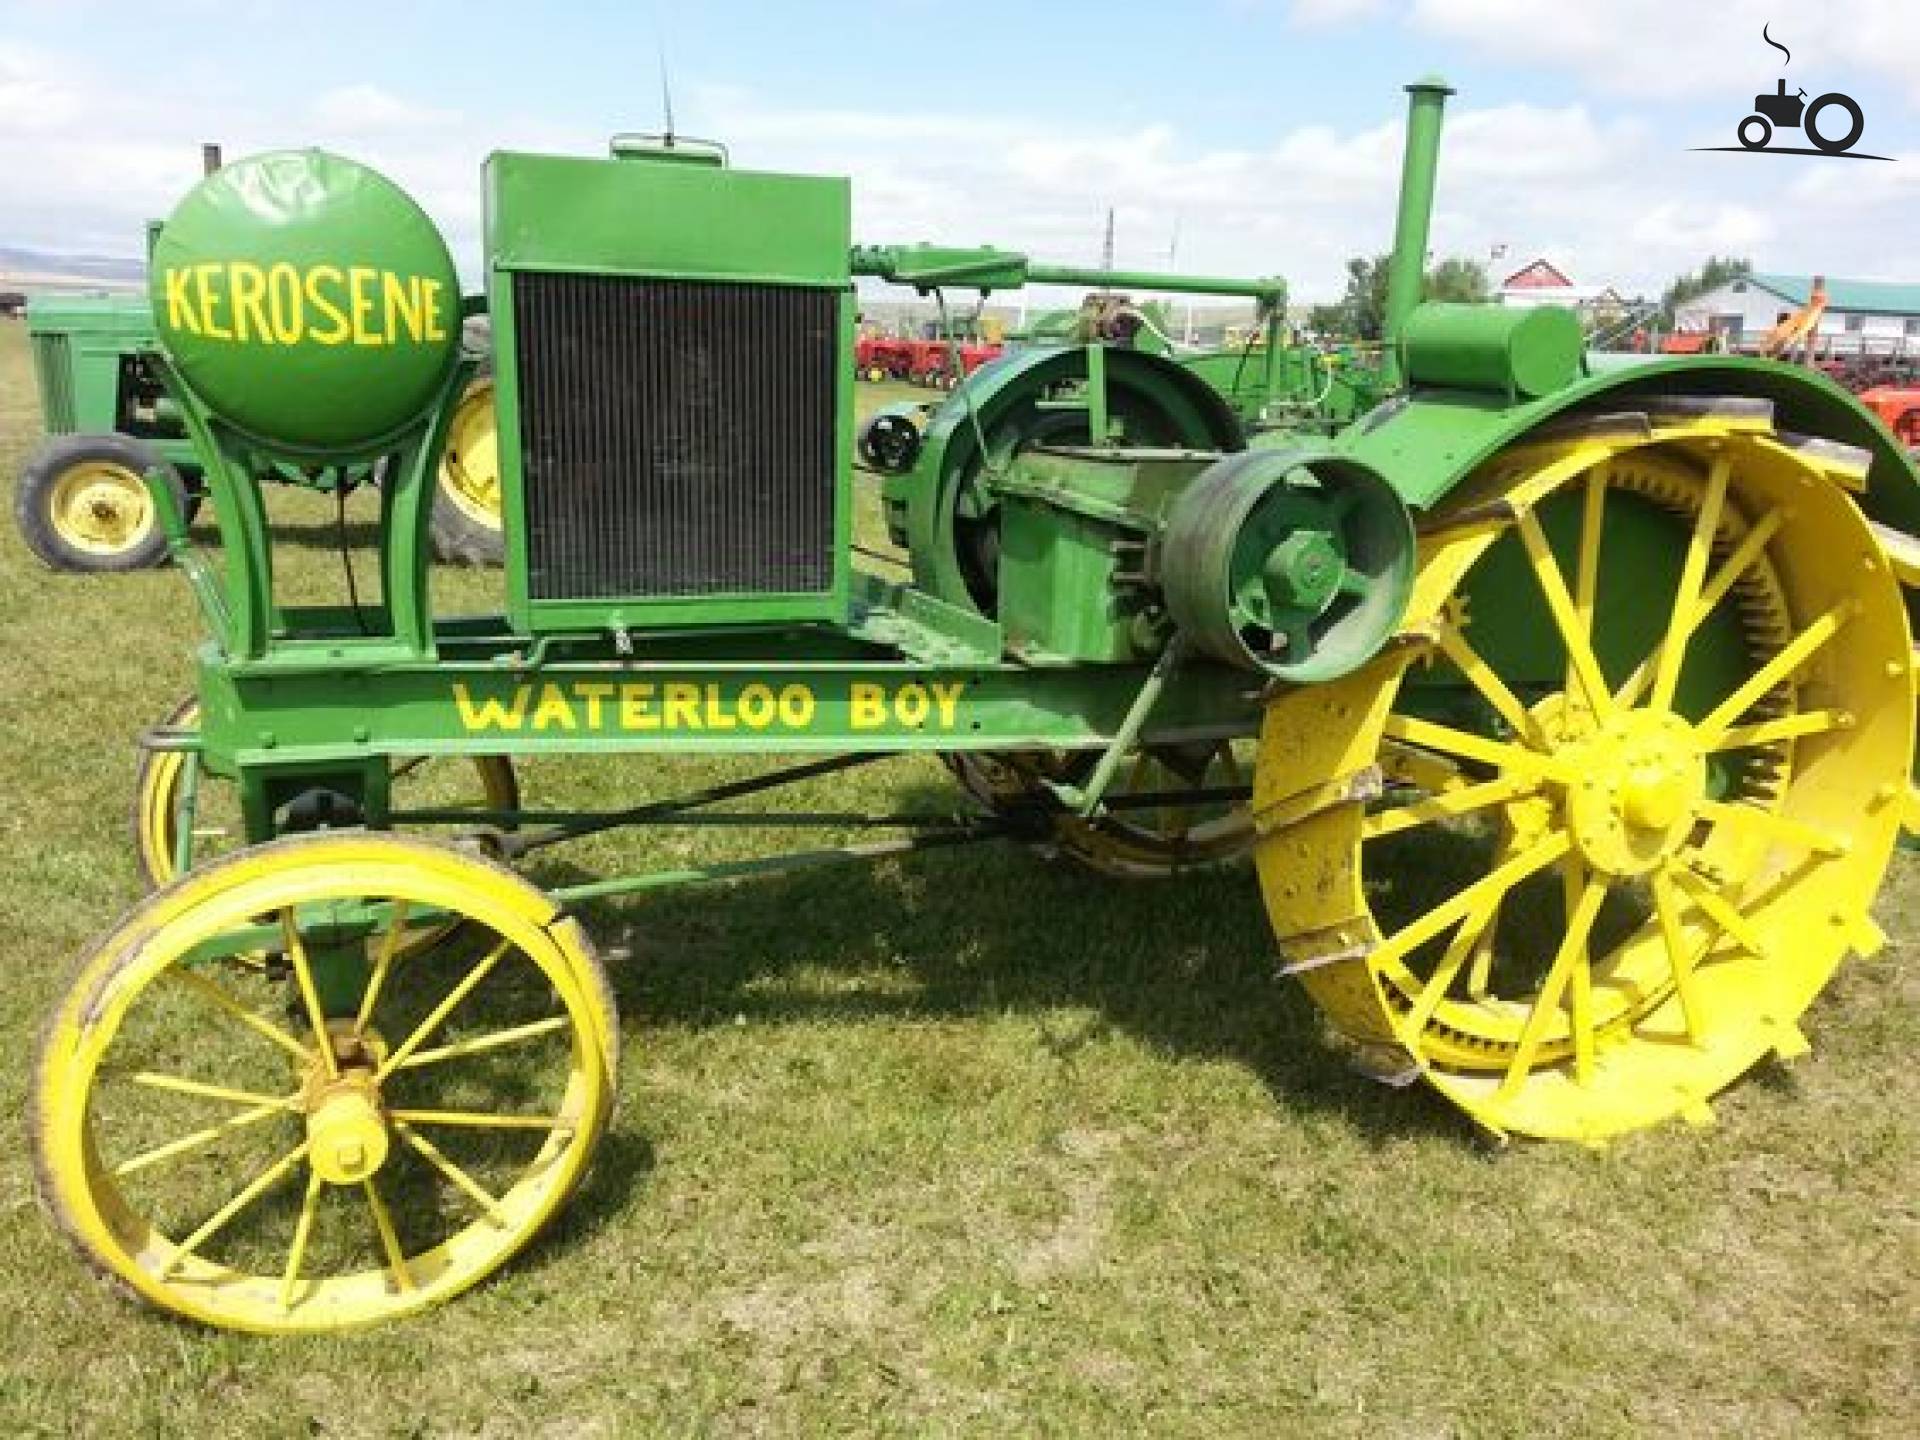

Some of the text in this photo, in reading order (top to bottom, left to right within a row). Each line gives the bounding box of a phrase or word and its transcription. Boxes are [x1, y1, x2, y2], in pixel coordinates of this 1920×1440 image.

[165, 260, 447, 345] KEROSENE
[452, 682, 965, 731] WATERLOO BOY
